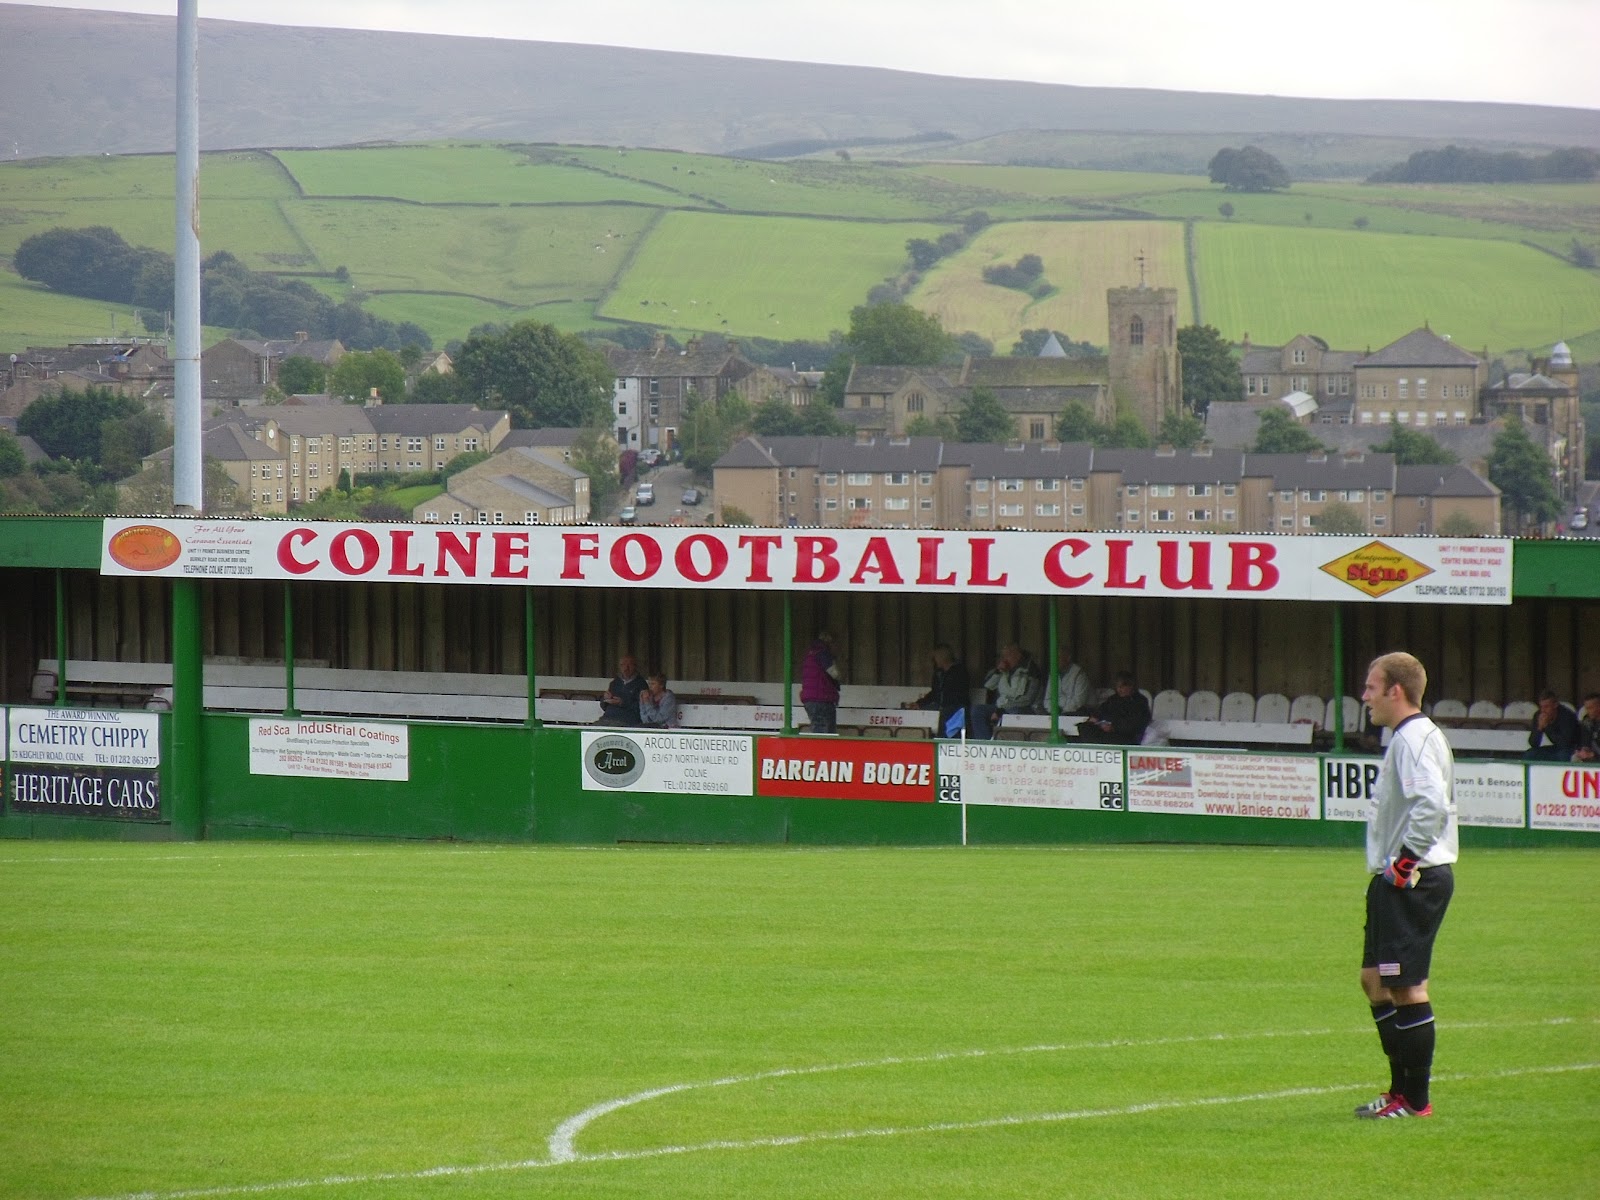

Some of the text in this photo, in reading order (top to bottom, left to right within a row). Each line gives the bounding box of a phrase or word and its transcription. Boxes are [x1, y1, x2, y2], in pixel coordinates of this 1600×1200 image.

[194, 525, 210, 534] For
[226, 526, 245, 534] Your
[276, 527, 1281, 591] COLNE FOOTBALL CLUB
[183, 565, 208, 574] TELEPHONE
[209, 565, 223, 574] COLNE
[1347, 562, 1408, 586] Signs
[1416, 585, 1447, 595] TELEPHONE
[1449, 586, 1467, 595] COLNE
[47, 710, 120, 721] THE AWARD WINNING
[754, 712, 783, 721] OFFICIA
[869, 716, 903, 725] SEATING
[19, 724, 149, 748] CEMETRY CHIPPY
[259, 727, 271, 736] Red
[360, 728, 400, 744] Coatings
[644, 737, 747, 752] ARCOL ENGINEERING
[19, 751, 45, 759] KEIGHLEY
[66, 753, 84, 761] COLNE
[95, 754, 108, 763] TEL:
[110, 755, 130, 764] 01282
[652, 754, 738, 765] 63/67 NORTH VALLEY RD
[940, 745, 1121, 764] NELSON AND COLNE COLLEGE
[598, 752, 627, 769] Arcol
[1130, 756, 1184, 772] LANLEE
[684, 768, 707, 778] COLNE
[761, 758, 931, 786] BARGAIN BOOZE
[990, 764, 1012, 774] part
[1016, 764, 1026, 772] of
[1488, 778, 1522, 787] Benson
[14, 774, 102, 806] HERITAGE
[107, 779, 155, 809] CARS
[1157, 791, 1194, 799] SPECIALISTS
[1198, 789, 1229, 798] Download
[1264, 792, 1277, 800] from
[1457, 791, 1523, 799] ccountants
[1334, 808, 1355, 818] Derby
[1536, 803, 1567, 816] 01282
